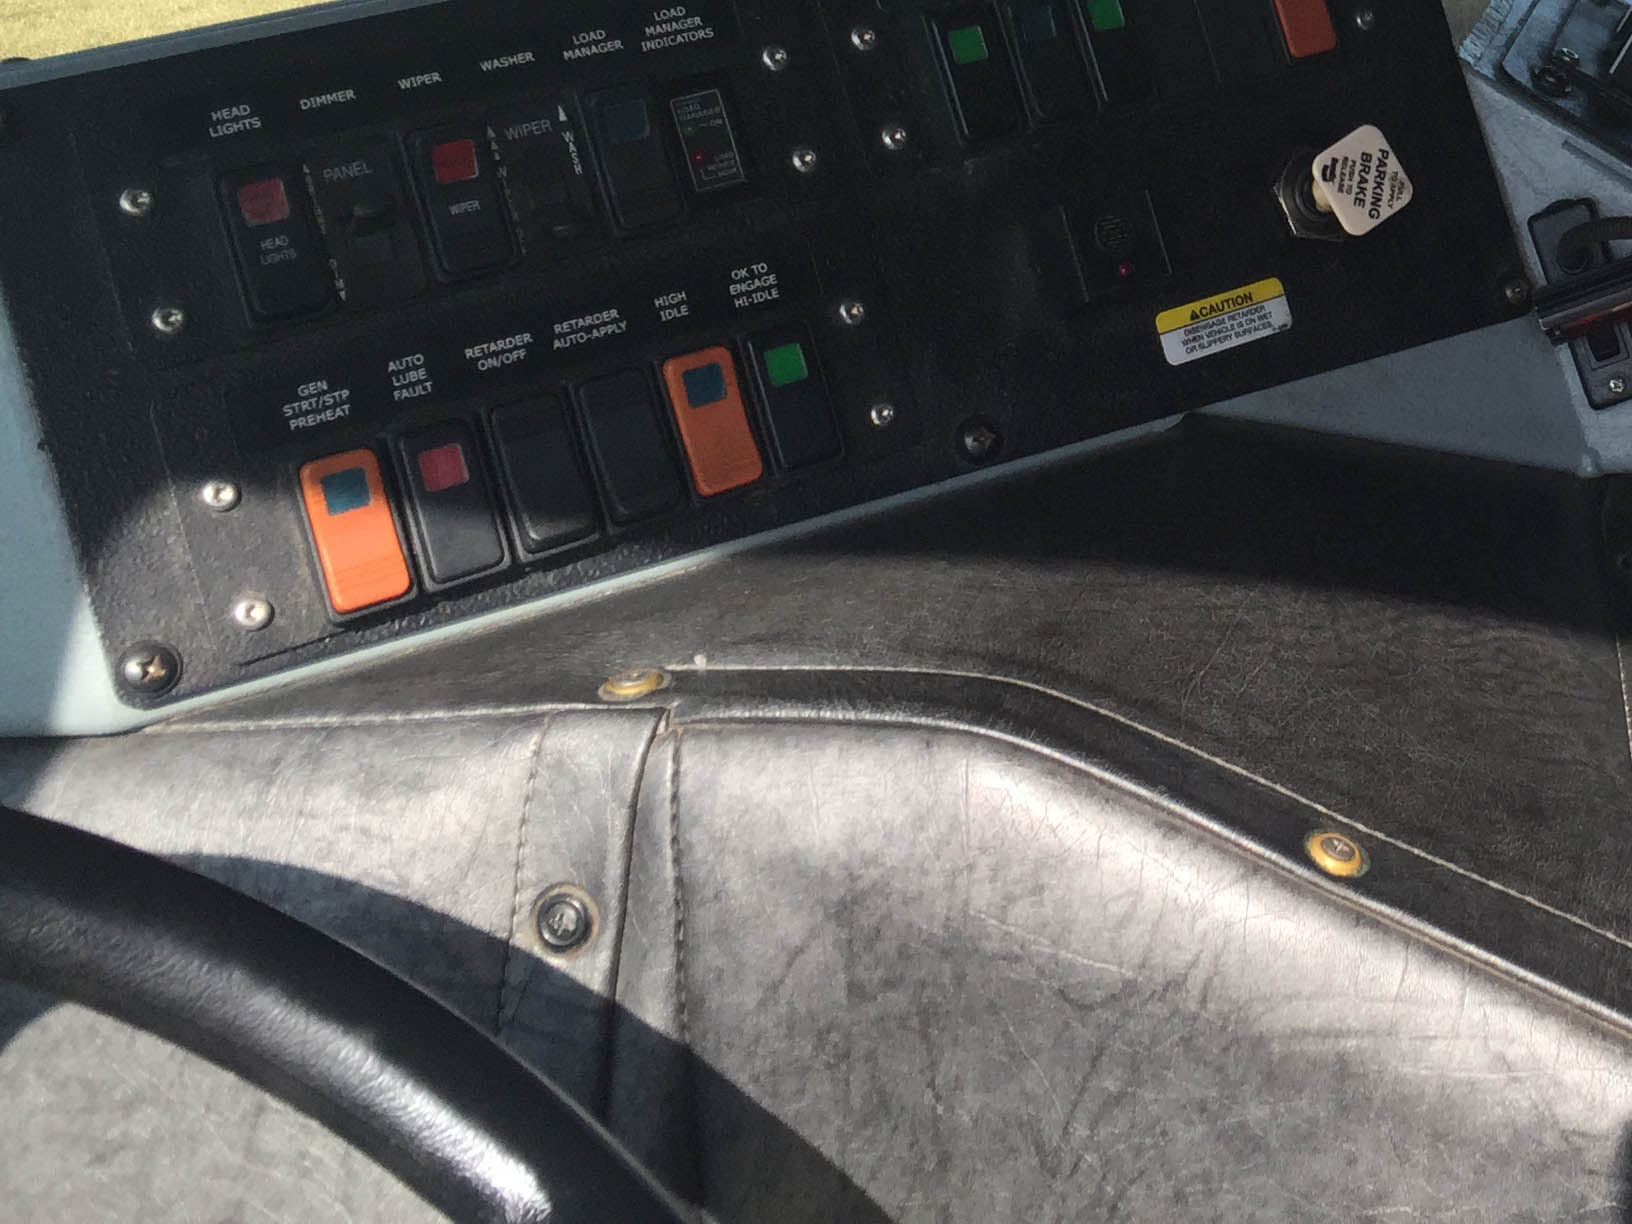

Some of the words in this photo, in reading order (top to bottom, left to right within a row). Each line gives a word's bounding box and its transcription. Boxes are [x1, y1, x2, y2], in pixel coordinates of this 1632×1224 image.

[653, 6, 686, 22] LOAD
[645, 16, 703, 37] MANAGER
[572, 29, 607, 46] LOAD
[641, 28, 714, 53] INDICATORS
[563, 39, 624, 62] MANAGER
[479, 51, 536, 73] WASHER
[397, 72, 442, 90] WIPER
[299, 89, 357, 110] DIMMER
[211, 104, 250, 122] HEAD
[208, 116, 262, 139] LIGHTS
[504, 118, 552, 141] WIPER
[561, 130, 585, 176] WASH
[322, 160, 375, 183] PANEL
[1353, 151, 1373, 209] BRAKE
[1368, 148, 1390, 220] PARKING
[260, 235, 289, 250] HEAD
[259, 248, 297, 265] LIGHTS
[731, 266, 749, 280] OK
[751, 262, 768, 274] TO
[729, 274, 778, 296] ENGAGE
[654, 290, 687, 308] HIGH
[734, 287, 780, 308] HI-IDLE
[1199, 291, 1254, 317] CAUTION
[553, 308, 621, 335] RETARDER
[659, 304, 689, 322] IDLE
[1227, 305, 1266, 323] RETARDER
[552, 320, 628, 351] AUTO-APPLY
[1204, 324, 1235, 340] VEHICLE
[464, 333, 534, 359] RETARDER
[1185, 343, 1199, 355] OR
[1198, 334, 1233, 350] SLIPPERY
[387, 353, 424, 374] AUTO
[477, 348, 528, 371] ON/OFF
[392, 367, 428, 387] LUBE
[297, 380, 329, 397] GEN
[393, 381, 433, 401] FAULT
[282, 388, 351, 417] STRT/STP
[289, 404, 351, 431] PREHEAT
